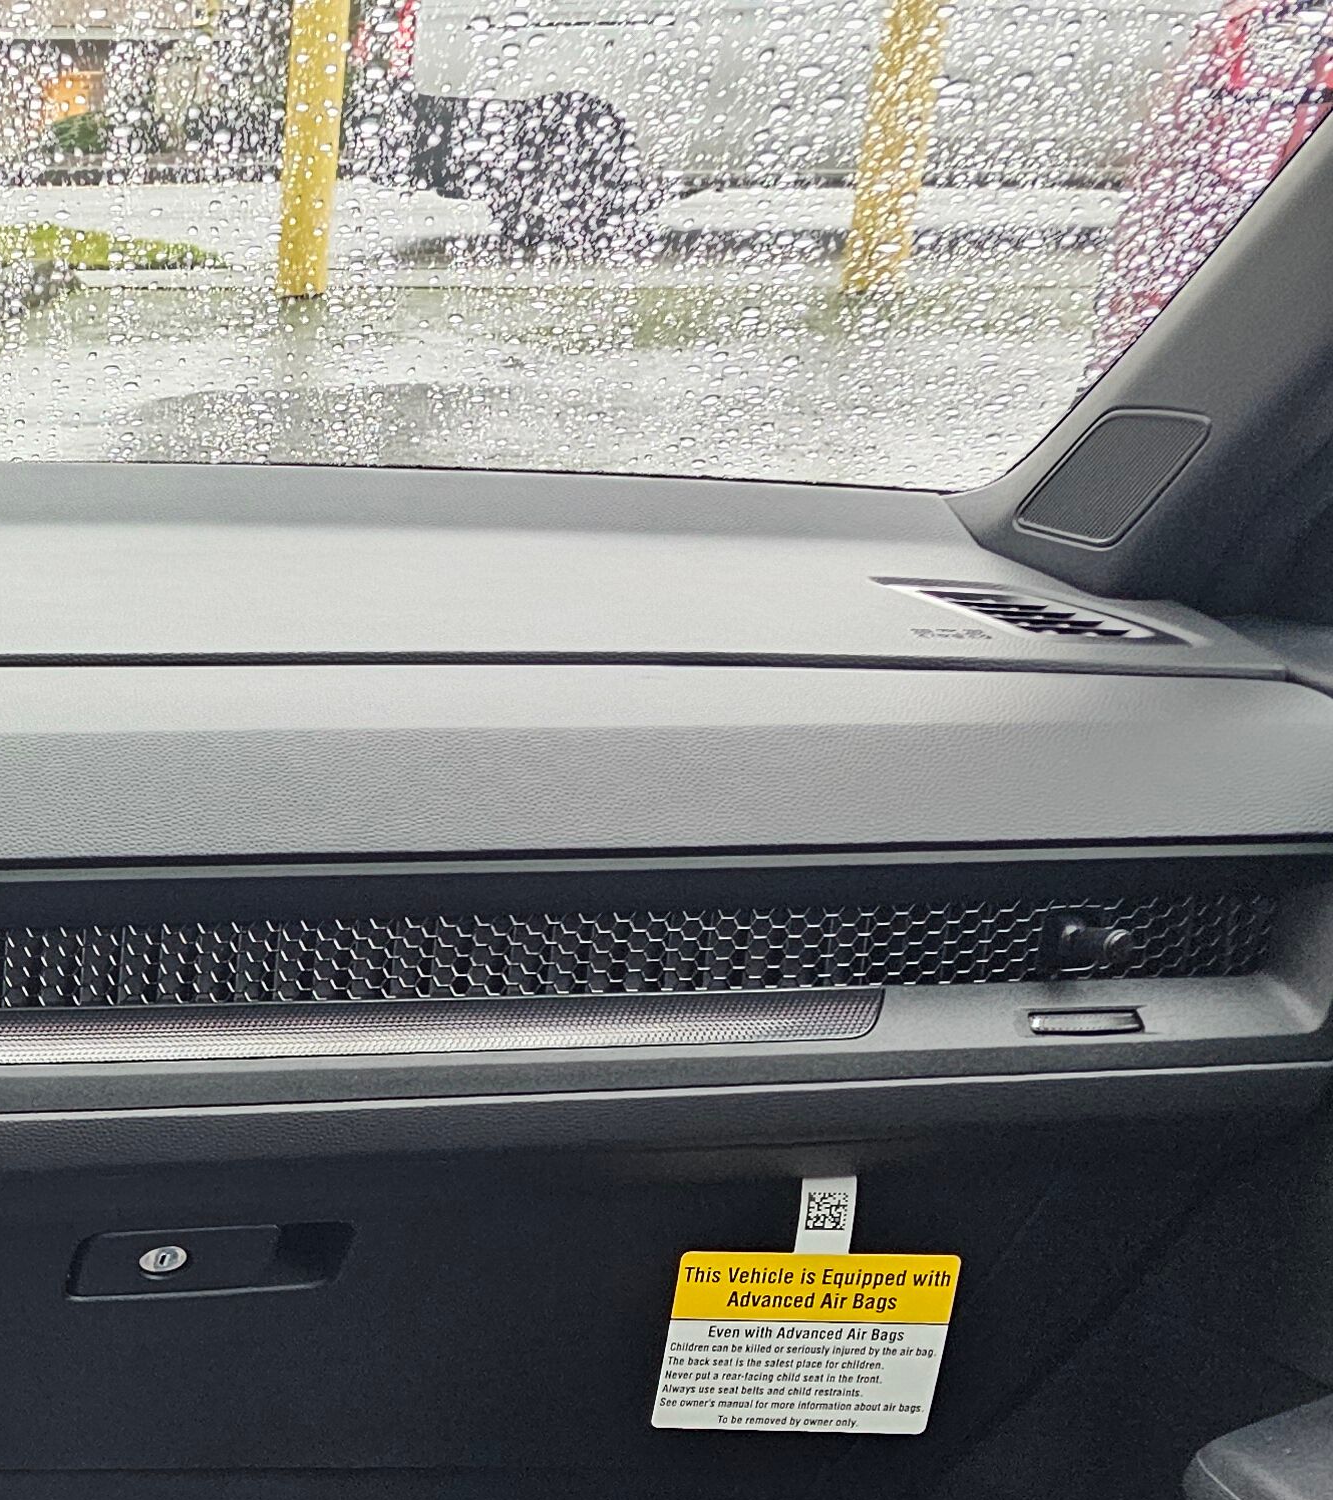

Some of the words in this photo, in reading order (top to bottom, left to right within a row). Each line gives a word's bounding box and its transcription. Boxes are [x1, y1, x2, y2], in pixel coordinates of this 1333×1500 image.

[684, 1266, 721, 1283] This
[728, 1267, 794, 1285] Vehicle
[800, 1268, 816, 1285] is
[822, 1268, 907, 1289] Equipped
[913, 1270, 951, 1287] with
[726, 1291, 815, 1308] Advanced
[820, 1293, 848, 1309] Air
[853, 1293, 898, 1313] Bags
[708, 1326, 740, 1338] Even
[745, 1326, 772, 1339] with
[776, 1327, 843, 1340] Advanced
[846, 1328, 867, 1340] Air
[871, 1328, 905, 1344] Bags
[670, 1342, 709, 1352] Children
[731, 1344, 743, 1353] be
[745, 1343, 771, 1354] killed
[774, 1346, 784, 1354] or
[786, 1345, 830, 1356] seriously
[832, 1346, 866, 1357] injured
[869, 1346, 880, 1357] by
[882, 1347, 898, 1356] the
[900, 1347, 914, 1356] air
[916, 1347, 937, 1358] bag.
[668, 1356, 684, 1366] The
[687, 1356, 710, 1366] back
[712, 1357, 732, 1367] seat
[735, 1358, 744, 1367] is
[747, 1359, 762, 1368] the
[764, 1359, 793, 1368] safest
[796, 1360, 822, 1370] place
[825, 1360, 839, 1369] for
[841, 1360, 885, 1370] children.
[665, 1370, 693, 1380] Never
[695, 1371, 711, 1381] put
[713, 1372, 719, 1380] a
[722, 1371, 773, 1383] rear-facing
[776, 1372, 800, 1382] child
[803, 1373, 824, 1383] seat
[826, 1374, 836, 1383] in
[838, 1374, 854, 1383] the
[856, 1374, 883, 1384] front.
[662, 1384, 696, 1395] Always
[698, 1386, 715, 1394] use
[718, 1385, 739, 1394] seat
[741, 1385, 764, 1396] belts
[767, 1386, 785, 1396] and
[787, 1386, 811, 1396] child
[814, 1387, 863, 1397] restraints.
[659, 1397, 677, 1407] See
[680, 1398, 715, 1408] owner's
[718, 1399, 753, 1409] manual
[755, 1400, 769, 1409] for
[770, 1401, 795, 1409] more
[797, 1401, 852, 1411] information
[854, 1402, 881, 1412] about
[883, 1403, 896, 1412] air
[898, 1403, 924, 1414] bags.
[718, 1415, 728, 1424] To
[731, 1415, 743, 1424] be
[745, 1416, 787, 1425] removed
[789, 1417, 800, 1427] by
[803, 1418, 834, 1427] owner
[836, 1418, 859, 1428] only.
